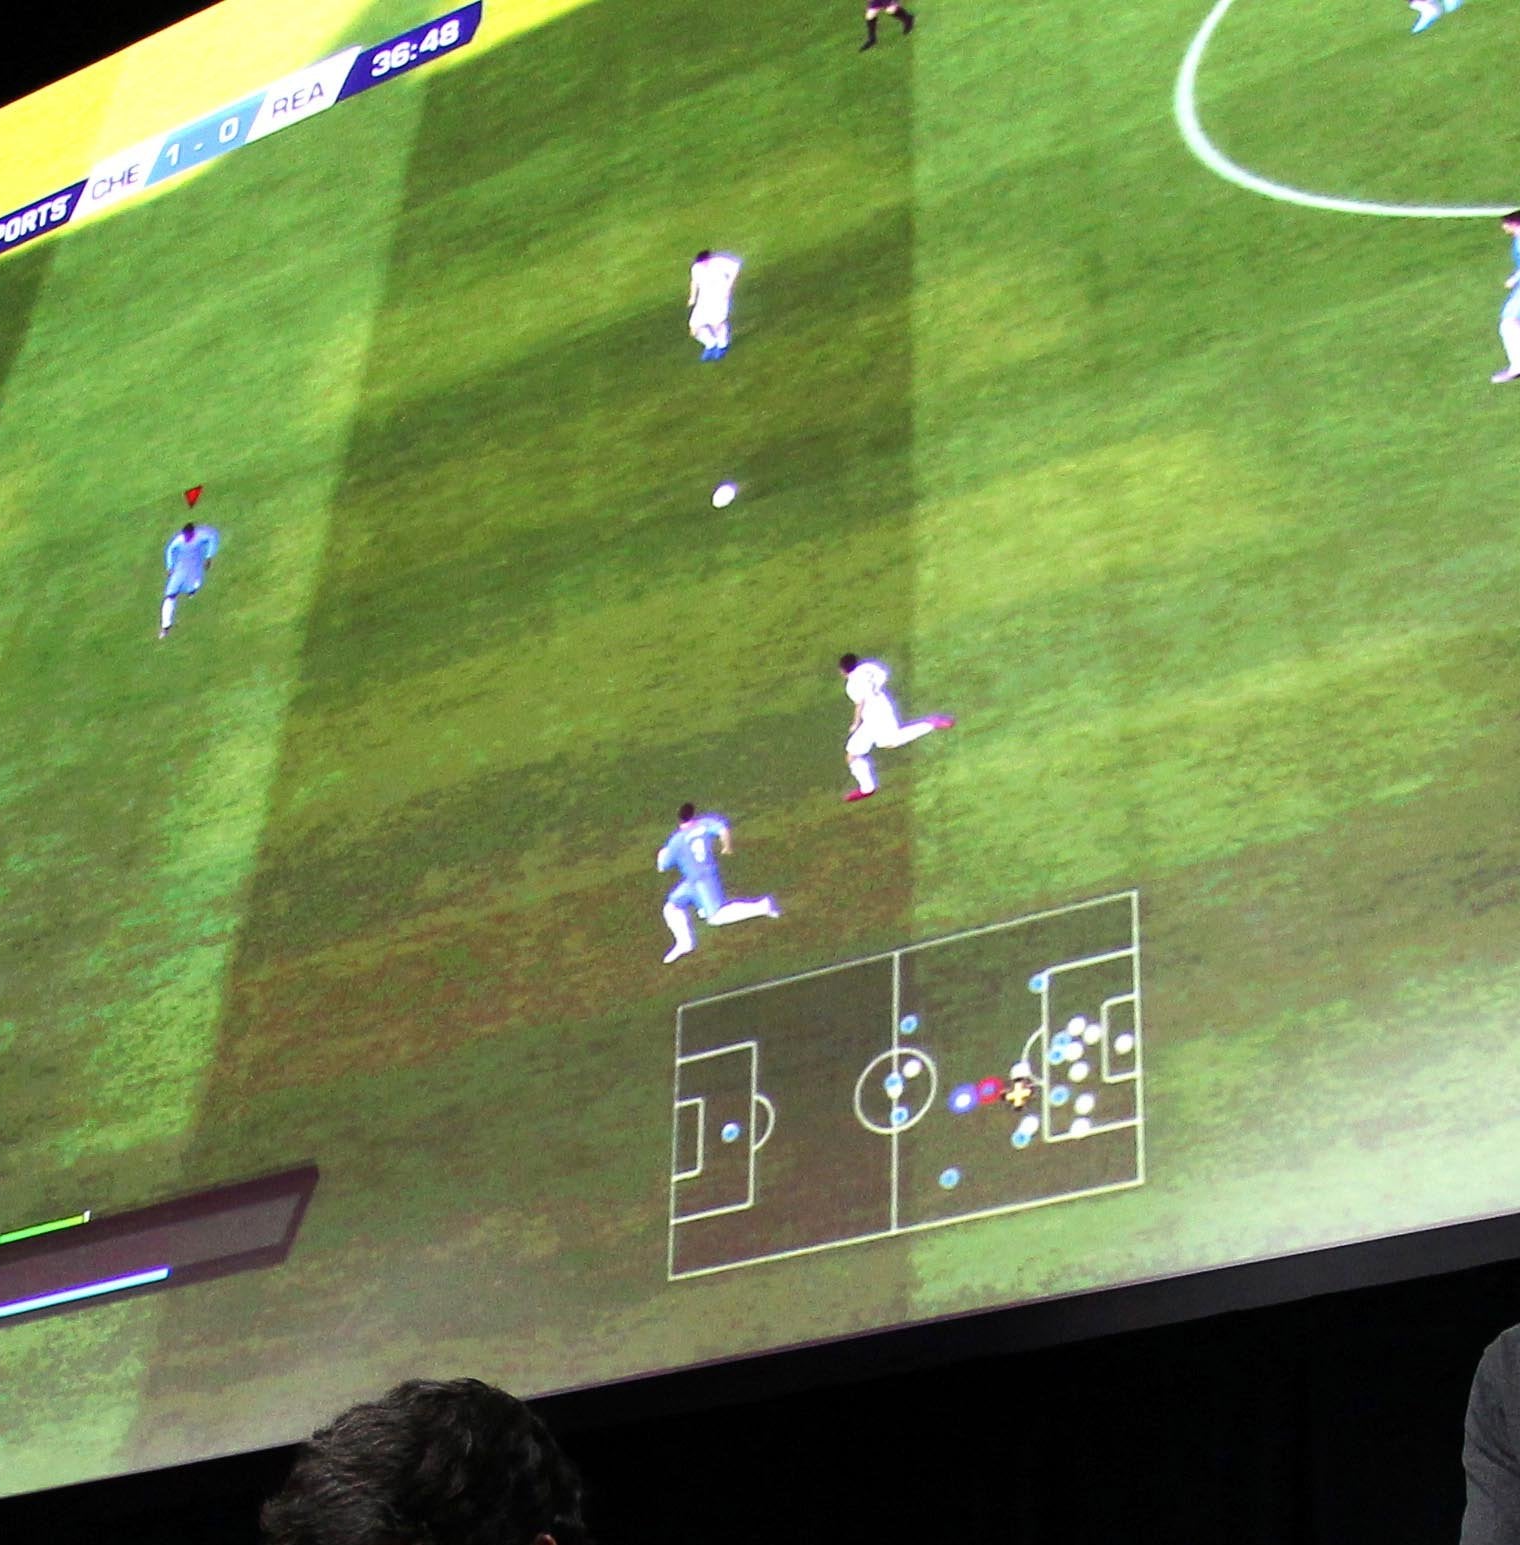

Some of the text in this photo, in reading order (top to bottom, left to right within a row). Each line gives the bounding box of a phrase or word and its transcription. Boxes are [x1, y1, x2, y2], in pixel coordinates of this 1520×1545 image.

[91, 165, 139, 201] CHE
[165, 143, 180, 167] 1
[218, 117, 241, 145] 0
[272, 82, 325, 119] REA
[371, 18, 461, 78] 36:48
